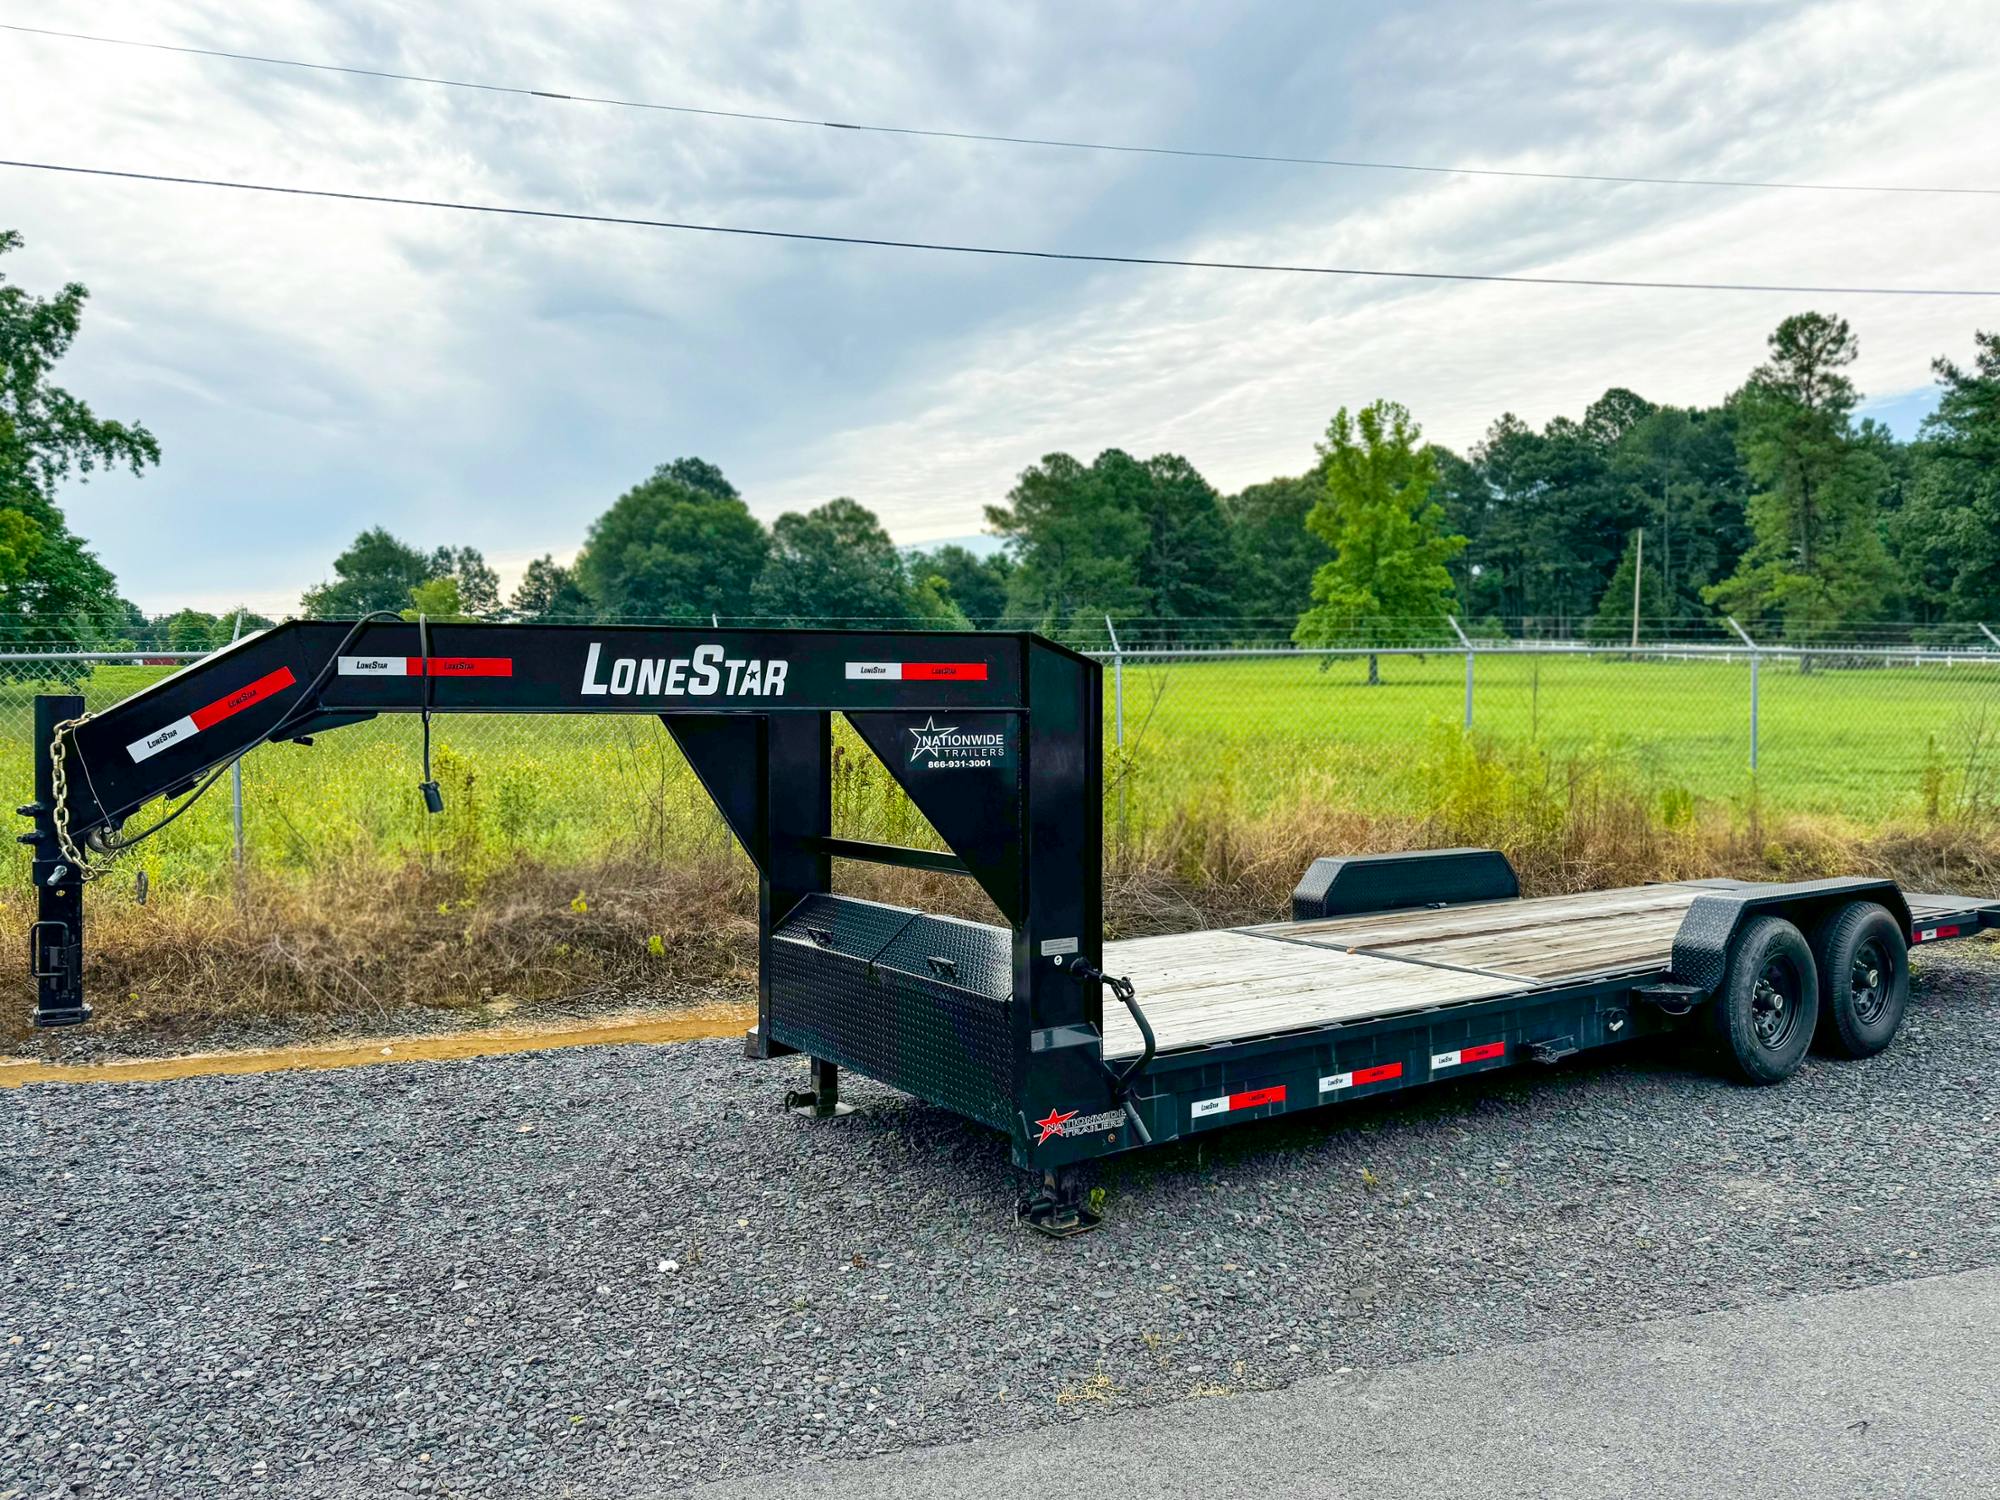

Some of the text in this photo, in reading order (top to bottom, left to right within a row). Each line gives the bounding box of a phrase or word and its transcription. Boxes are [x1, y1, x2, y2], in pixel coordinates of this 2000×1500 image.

[922, 734, 1005, 746] NATIONWIDE
[944, 748, 1005, 757] TRAILERS
[928, 759, 992, 769] 866-931-3001
[1063, 1116, 1125, 1138] TRAILERS
